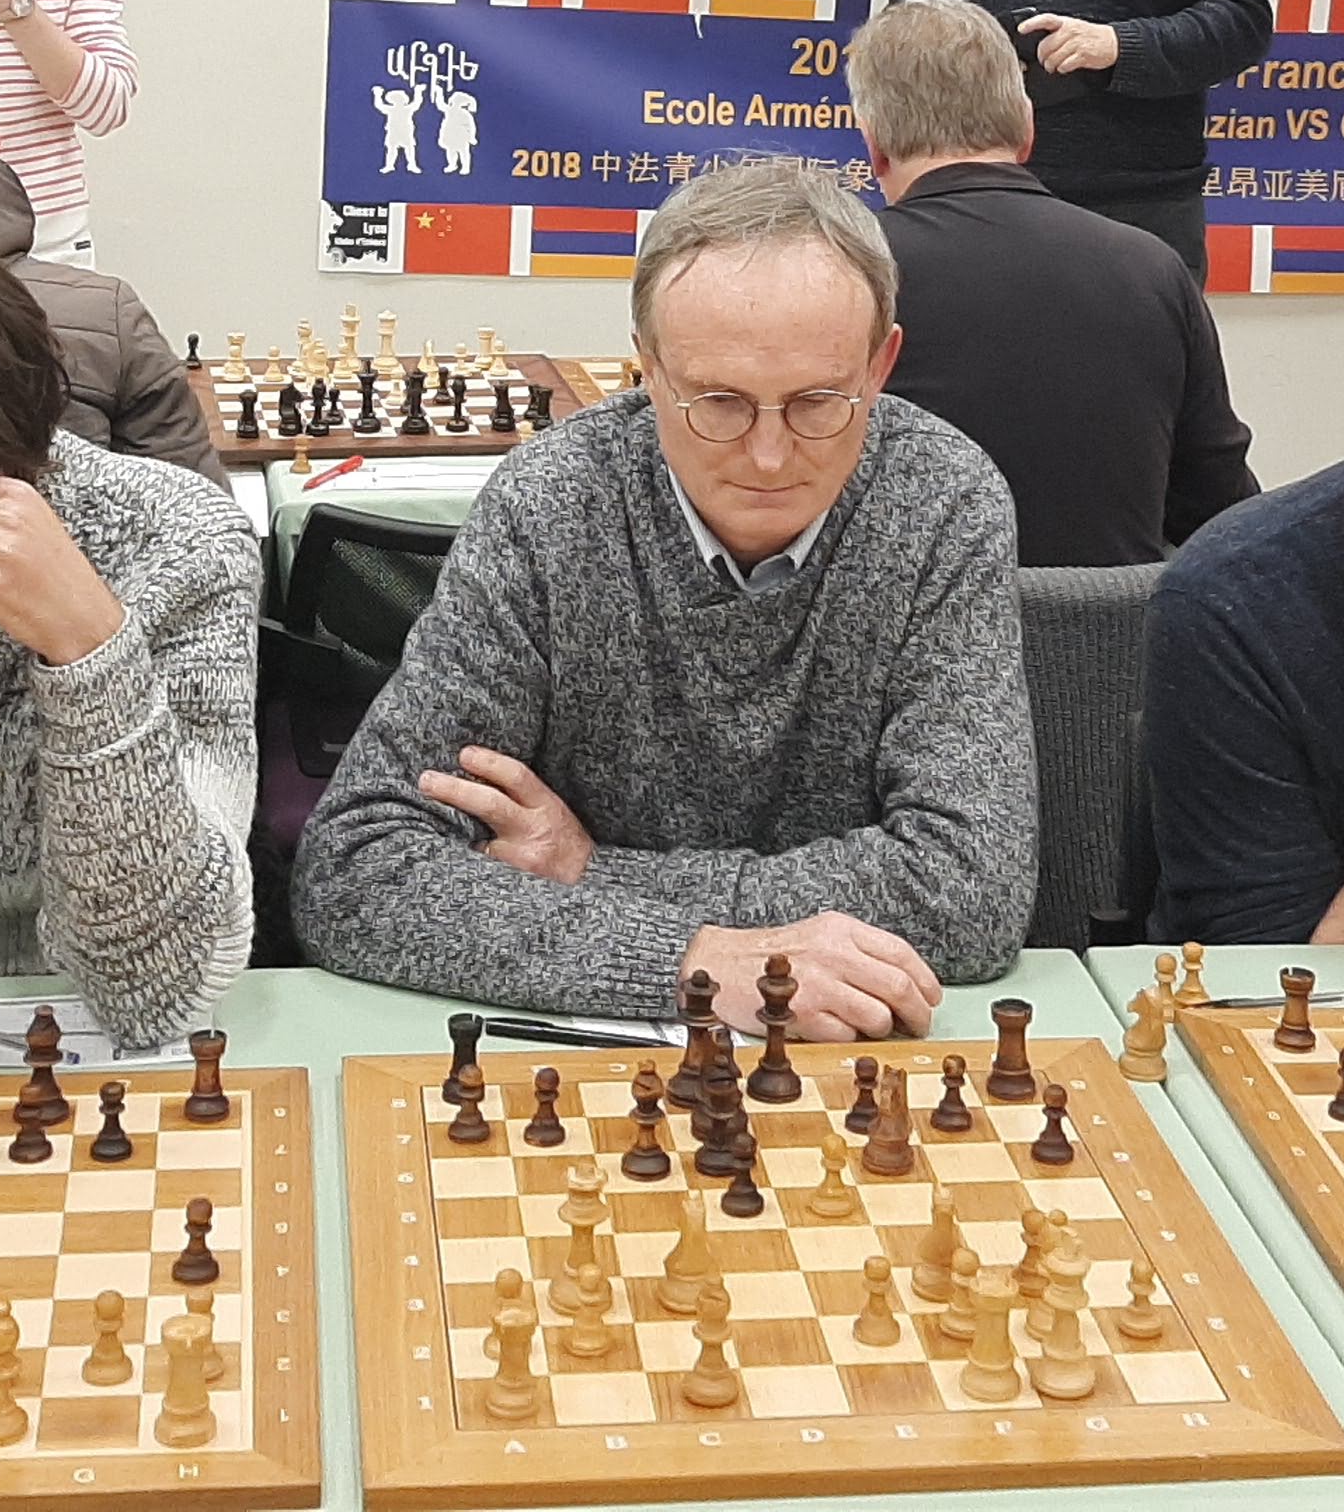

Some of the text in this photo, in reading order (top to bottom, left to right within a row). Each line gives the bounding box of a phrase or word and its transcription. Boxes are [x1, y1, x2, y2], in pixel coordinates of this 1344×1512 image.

[788, 37, 848, 76] 20
[642, 90, 861, 130] Ecole Armén
[1285, 108, 1330, 141] VS
[510, 148, 582, 179] 2018
